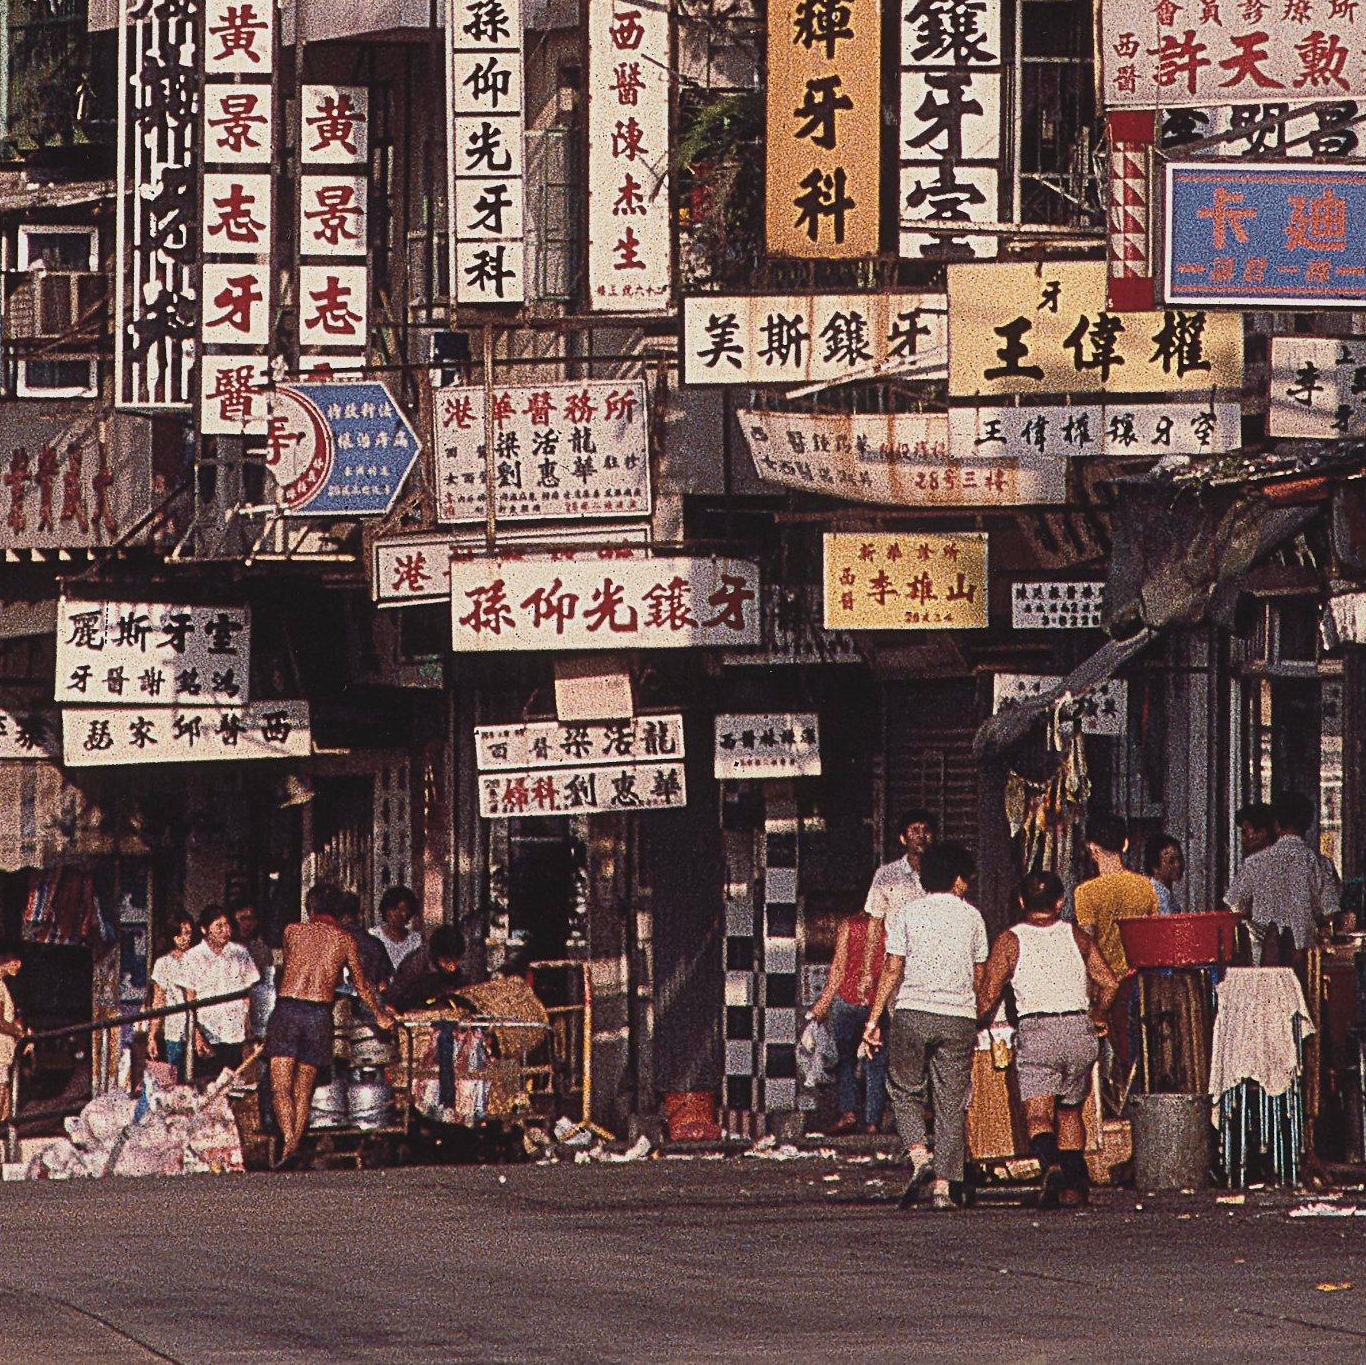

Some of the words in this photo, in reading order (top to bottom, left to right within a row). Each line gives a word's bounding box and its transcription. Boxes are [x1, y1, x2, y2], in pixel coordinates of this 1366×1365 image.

[205, 4, 269, 421] 黃景志牙醫
[304, 93, 367, 380] 黃景志
[608, 9, 649, 272] 西醫陳杰生
